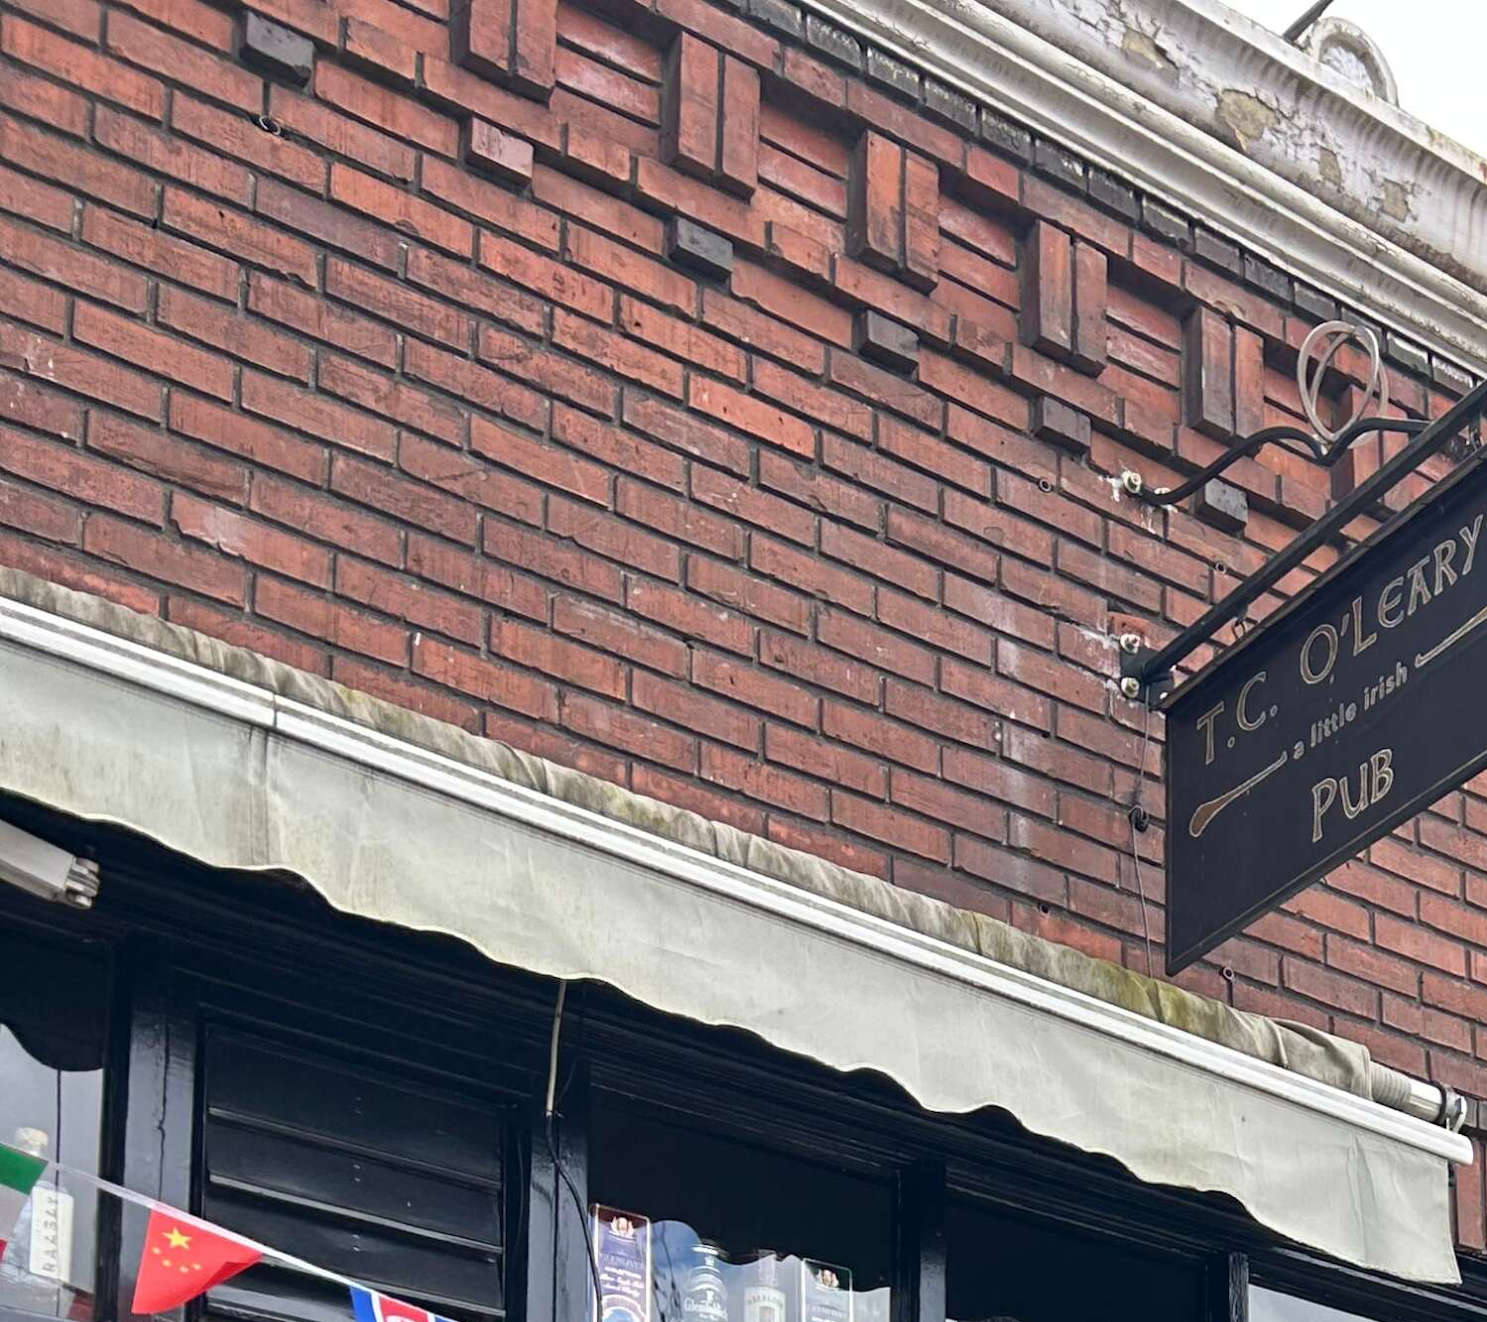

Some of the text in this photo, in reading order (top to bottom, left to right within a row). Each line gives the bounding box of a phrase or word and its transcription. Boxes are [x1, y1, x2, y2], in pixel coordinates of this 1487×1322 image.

[1293, 661, 1408, 759] a little irish
[1311, 748, 1394, 843] PUB
